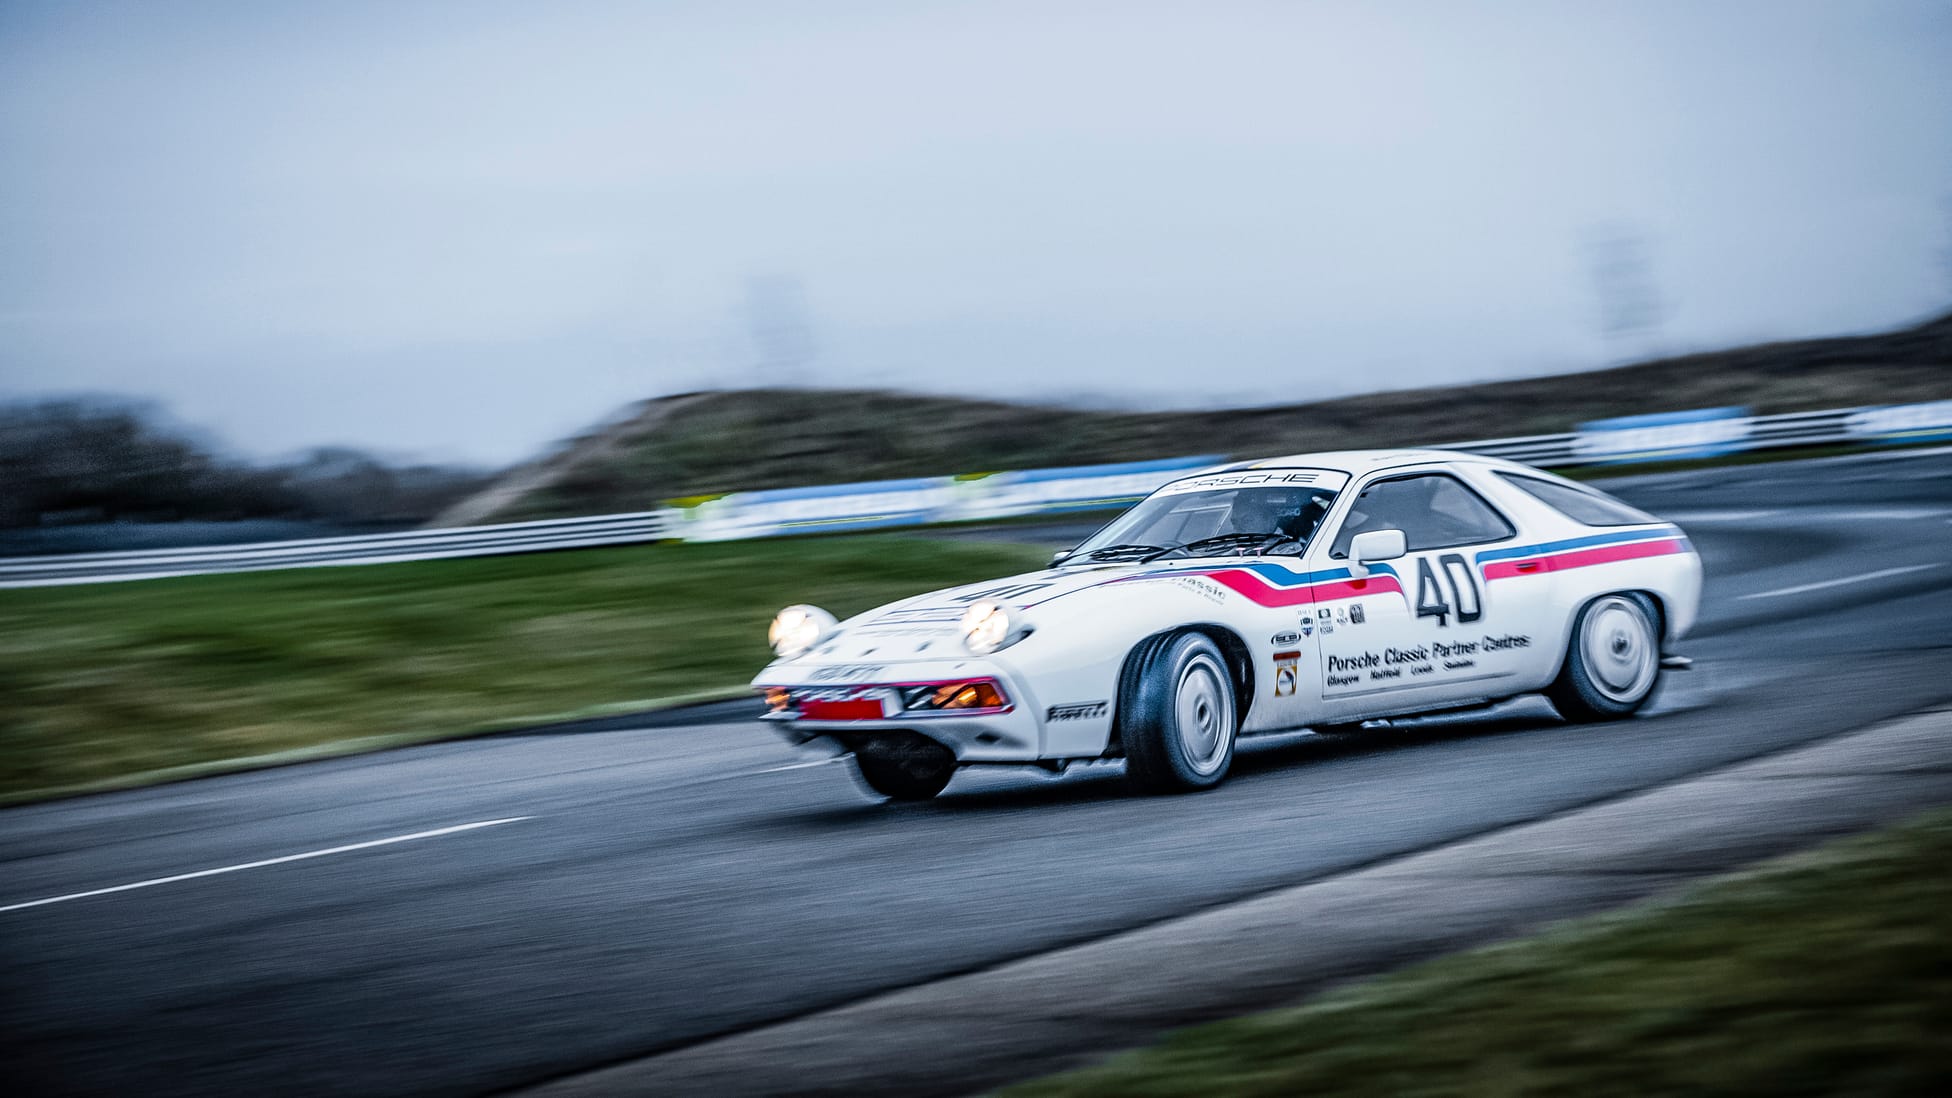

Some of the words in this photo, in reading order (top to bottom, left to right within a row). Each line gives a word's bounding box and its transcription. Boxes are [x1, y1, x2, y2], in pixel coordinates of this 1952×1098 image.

[1170, 474, 1319, 491] ORSCHE
[1417, 553, 1482, 627] 40
[1328, 650, 1380, 672] Porsche
[1384, 644, 1429, 665] Classic
[1432, 641, 1479, 659] Partner
[1482, 634, 1531, 652] Centres
